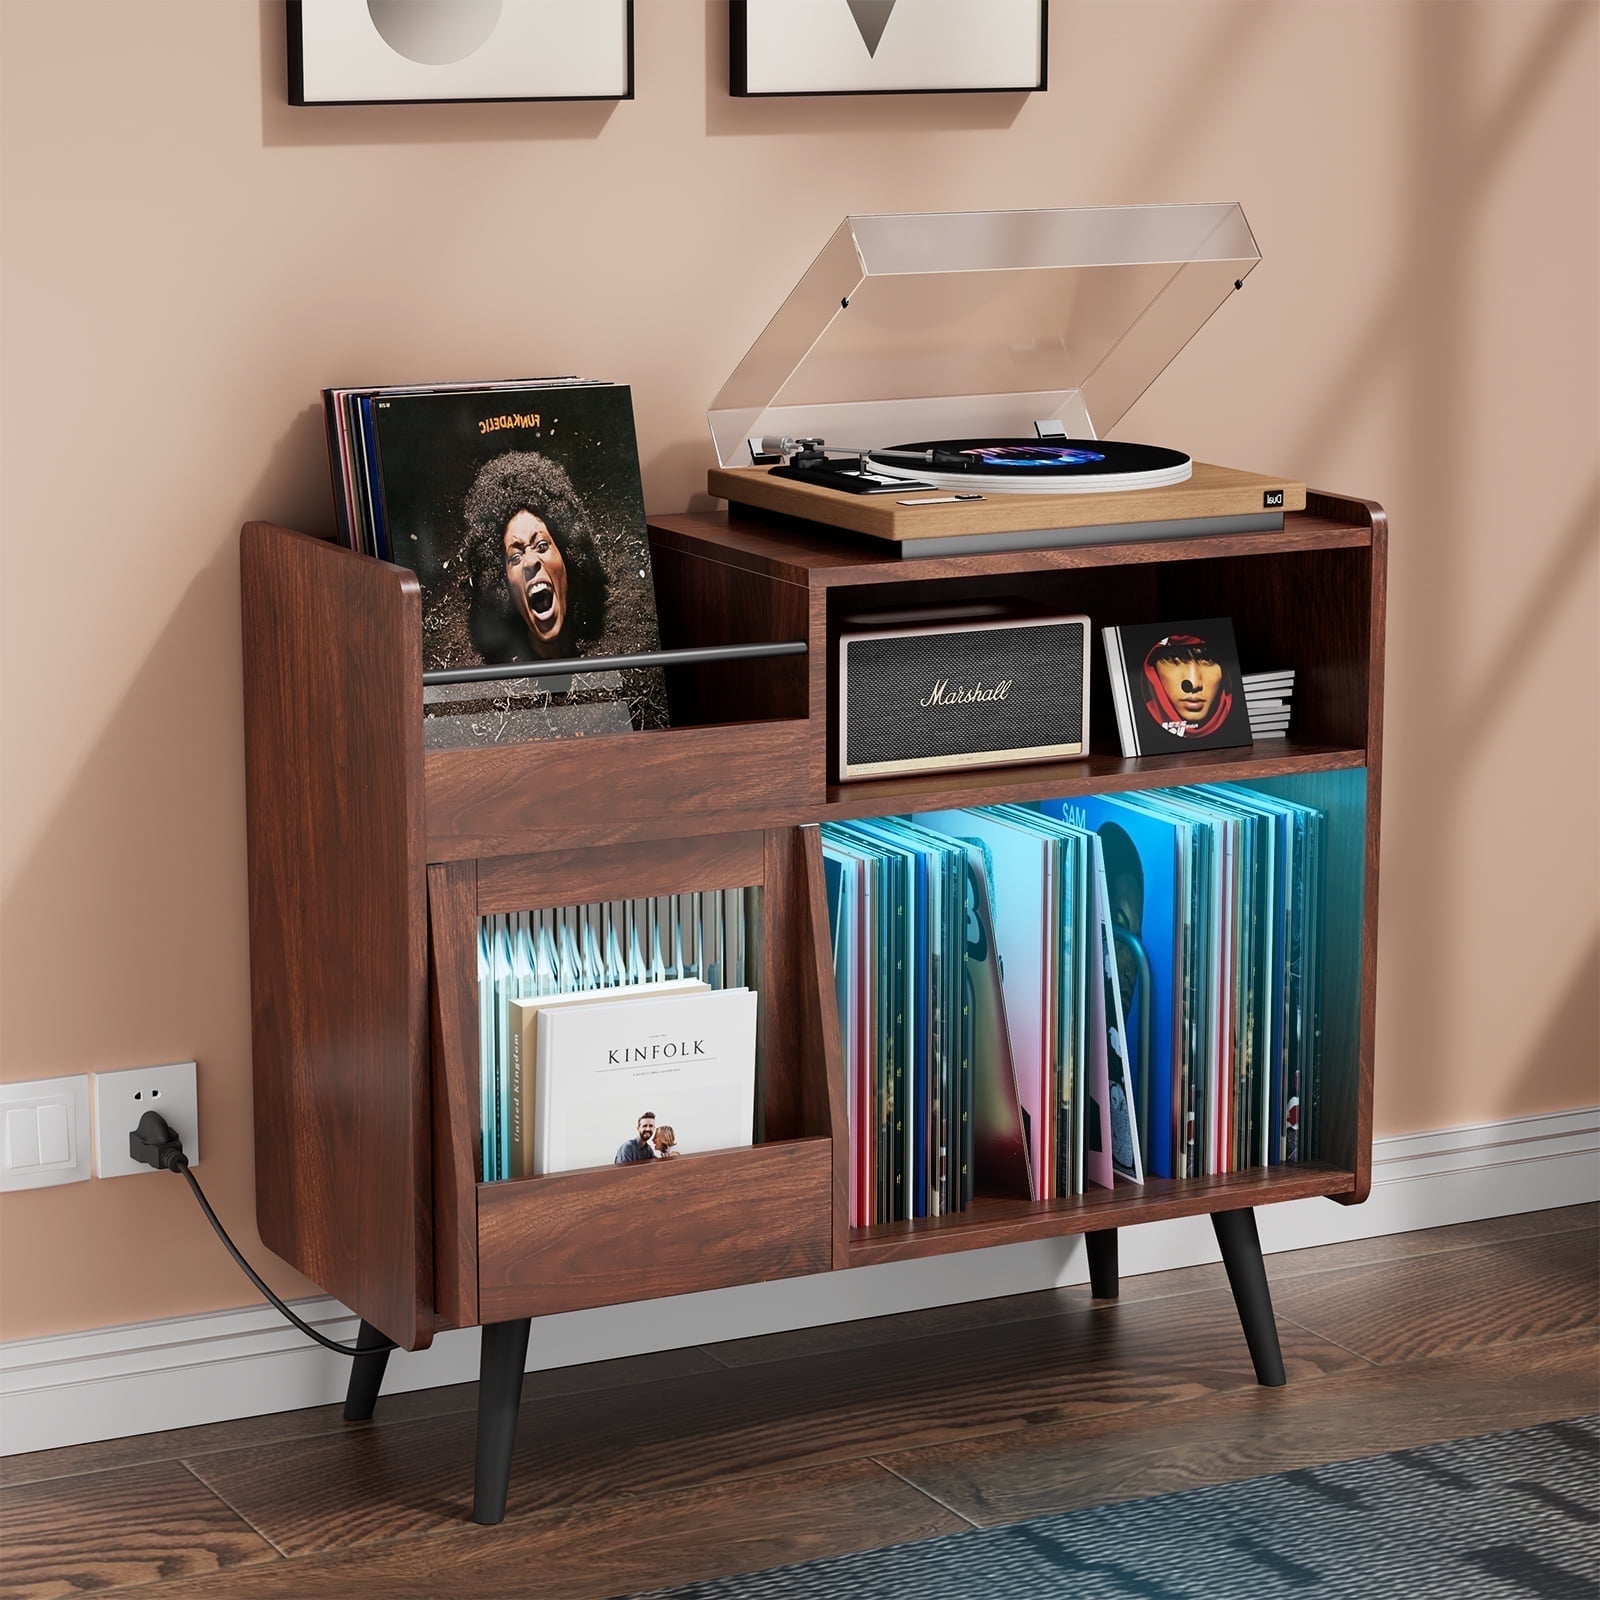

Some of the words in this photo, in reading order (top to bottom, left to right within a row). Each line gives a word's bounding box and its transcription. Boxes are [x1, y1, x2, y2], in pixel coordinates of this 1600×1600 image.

[920, 679, 1013, 707] Marshall
[1062, 802, 1086, 830] SAM
[513, 1034, 521, 1094] Kingdom
[608, 1039, 705, 1065] KINFOLK
[513, 1098, 521, 1143] United
